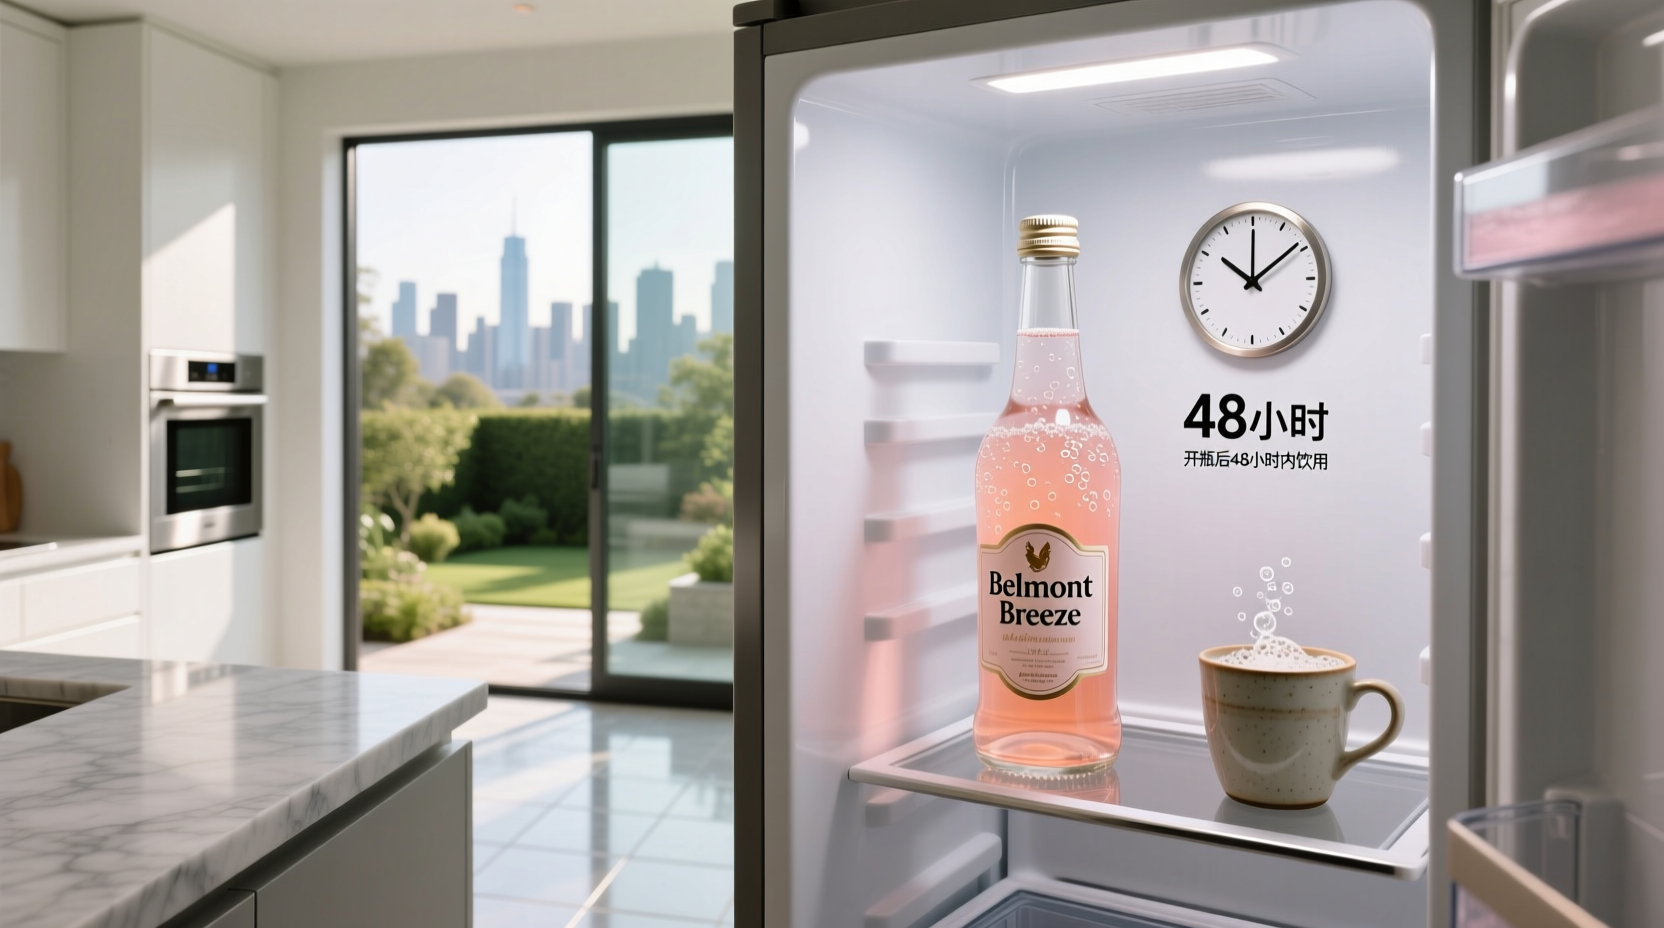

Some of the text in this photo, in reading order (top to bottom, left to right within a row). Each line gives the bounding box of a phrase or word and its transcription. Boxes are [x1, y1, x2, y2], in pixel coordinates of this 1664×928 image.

[1183, 393, 1329, 442] 48小时
[1183, 450, 1328, 470] 开瓶后48小时内饮用
[989, 570, 1093, 598] Belmont
[999, 600, 1081, 626] Breeze
